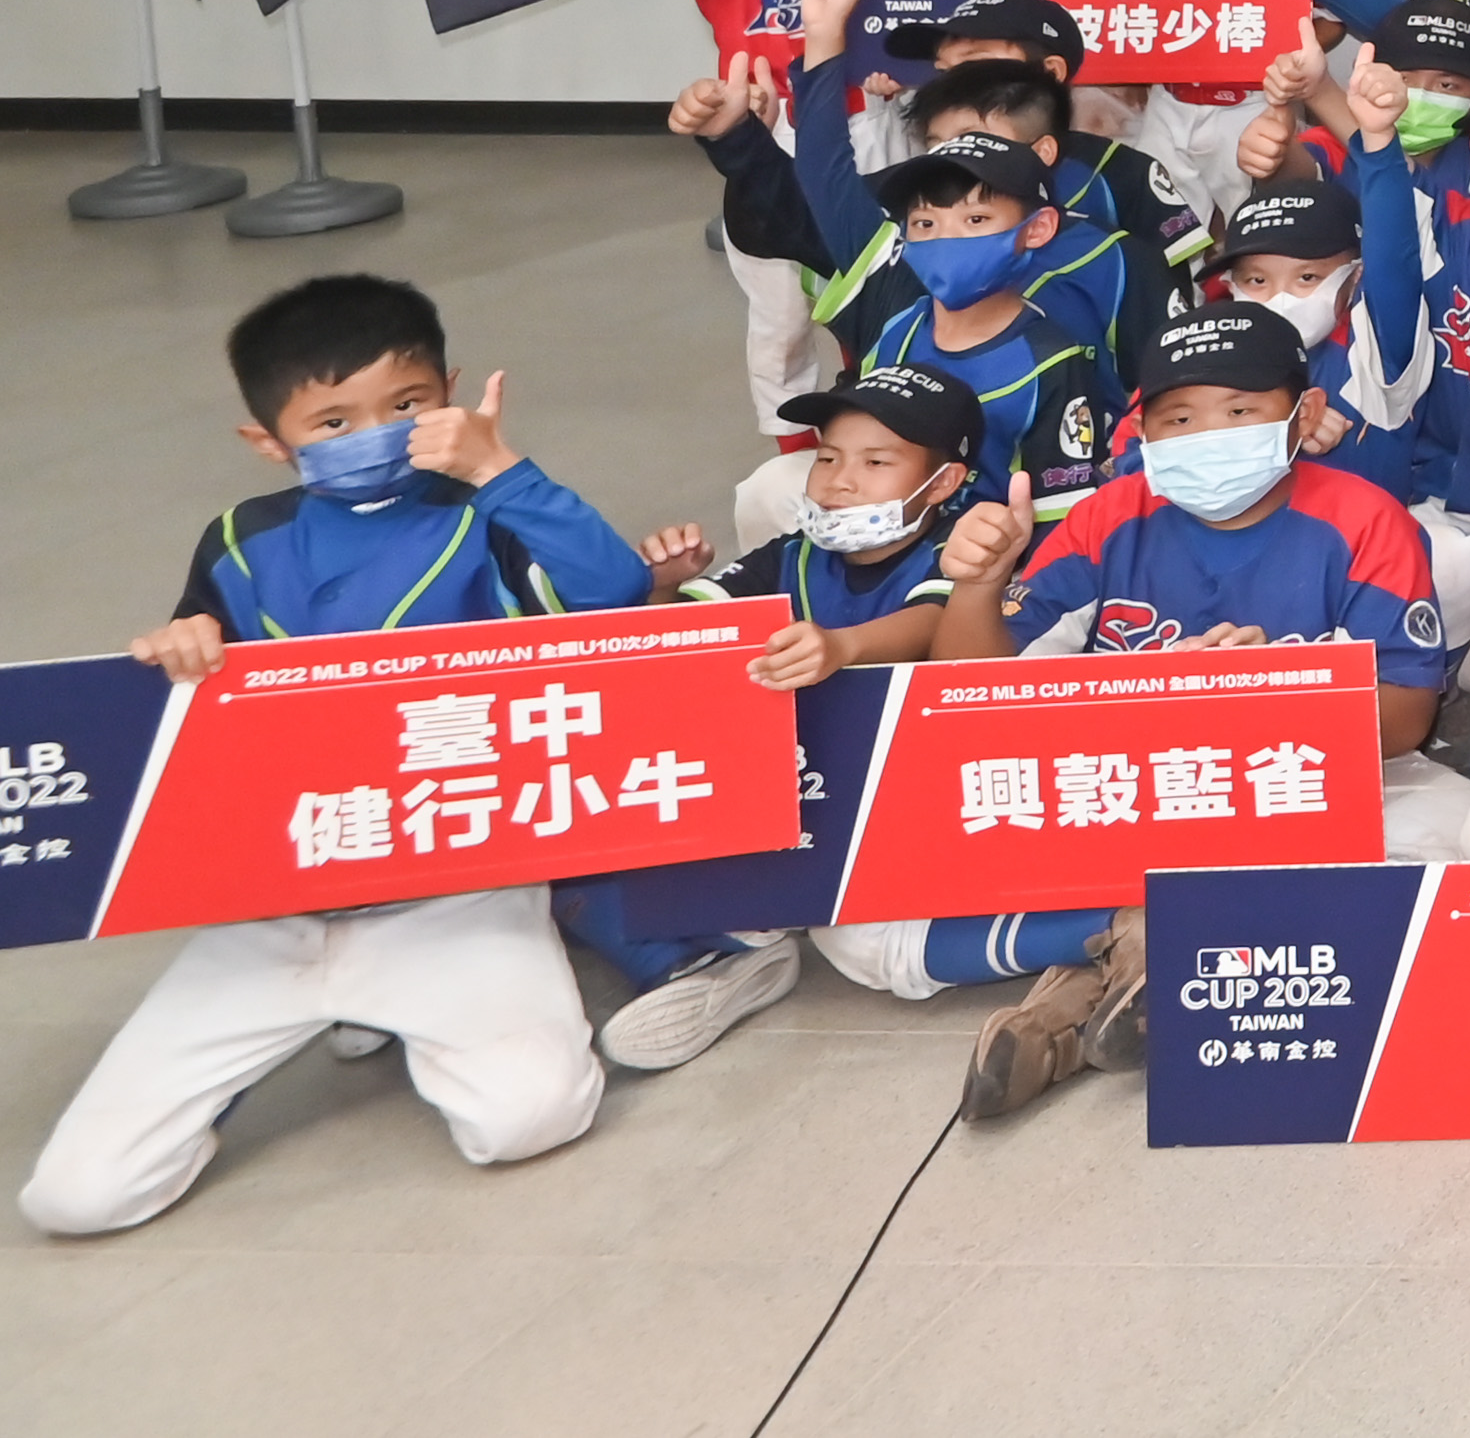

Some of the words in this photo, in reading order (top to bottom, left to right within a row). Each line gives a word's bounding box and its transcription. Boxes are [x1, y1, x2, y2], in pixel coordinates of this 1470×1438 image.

[244, 666, 309, 690] 2022
[311, 661, 369, 683] MLB
[372, 655, 427, 677] CUP
[431, 645, 534, 672] TAIWAN
[395, 682, 605, 774] 臺中
[959, 740, 1329, 836] 興穀藍雀
[287, 750, 715, 869] 健行小牛
[1254, 944, 1337, 977] MLB
[1179, 977, 1260, 1011] CUP
[1263, 975, 1352, 1009] 2022
[1229, 1014, 1304, 1033] TAIWAN
[1231, 1038, 1338, 1064] 華南金控
